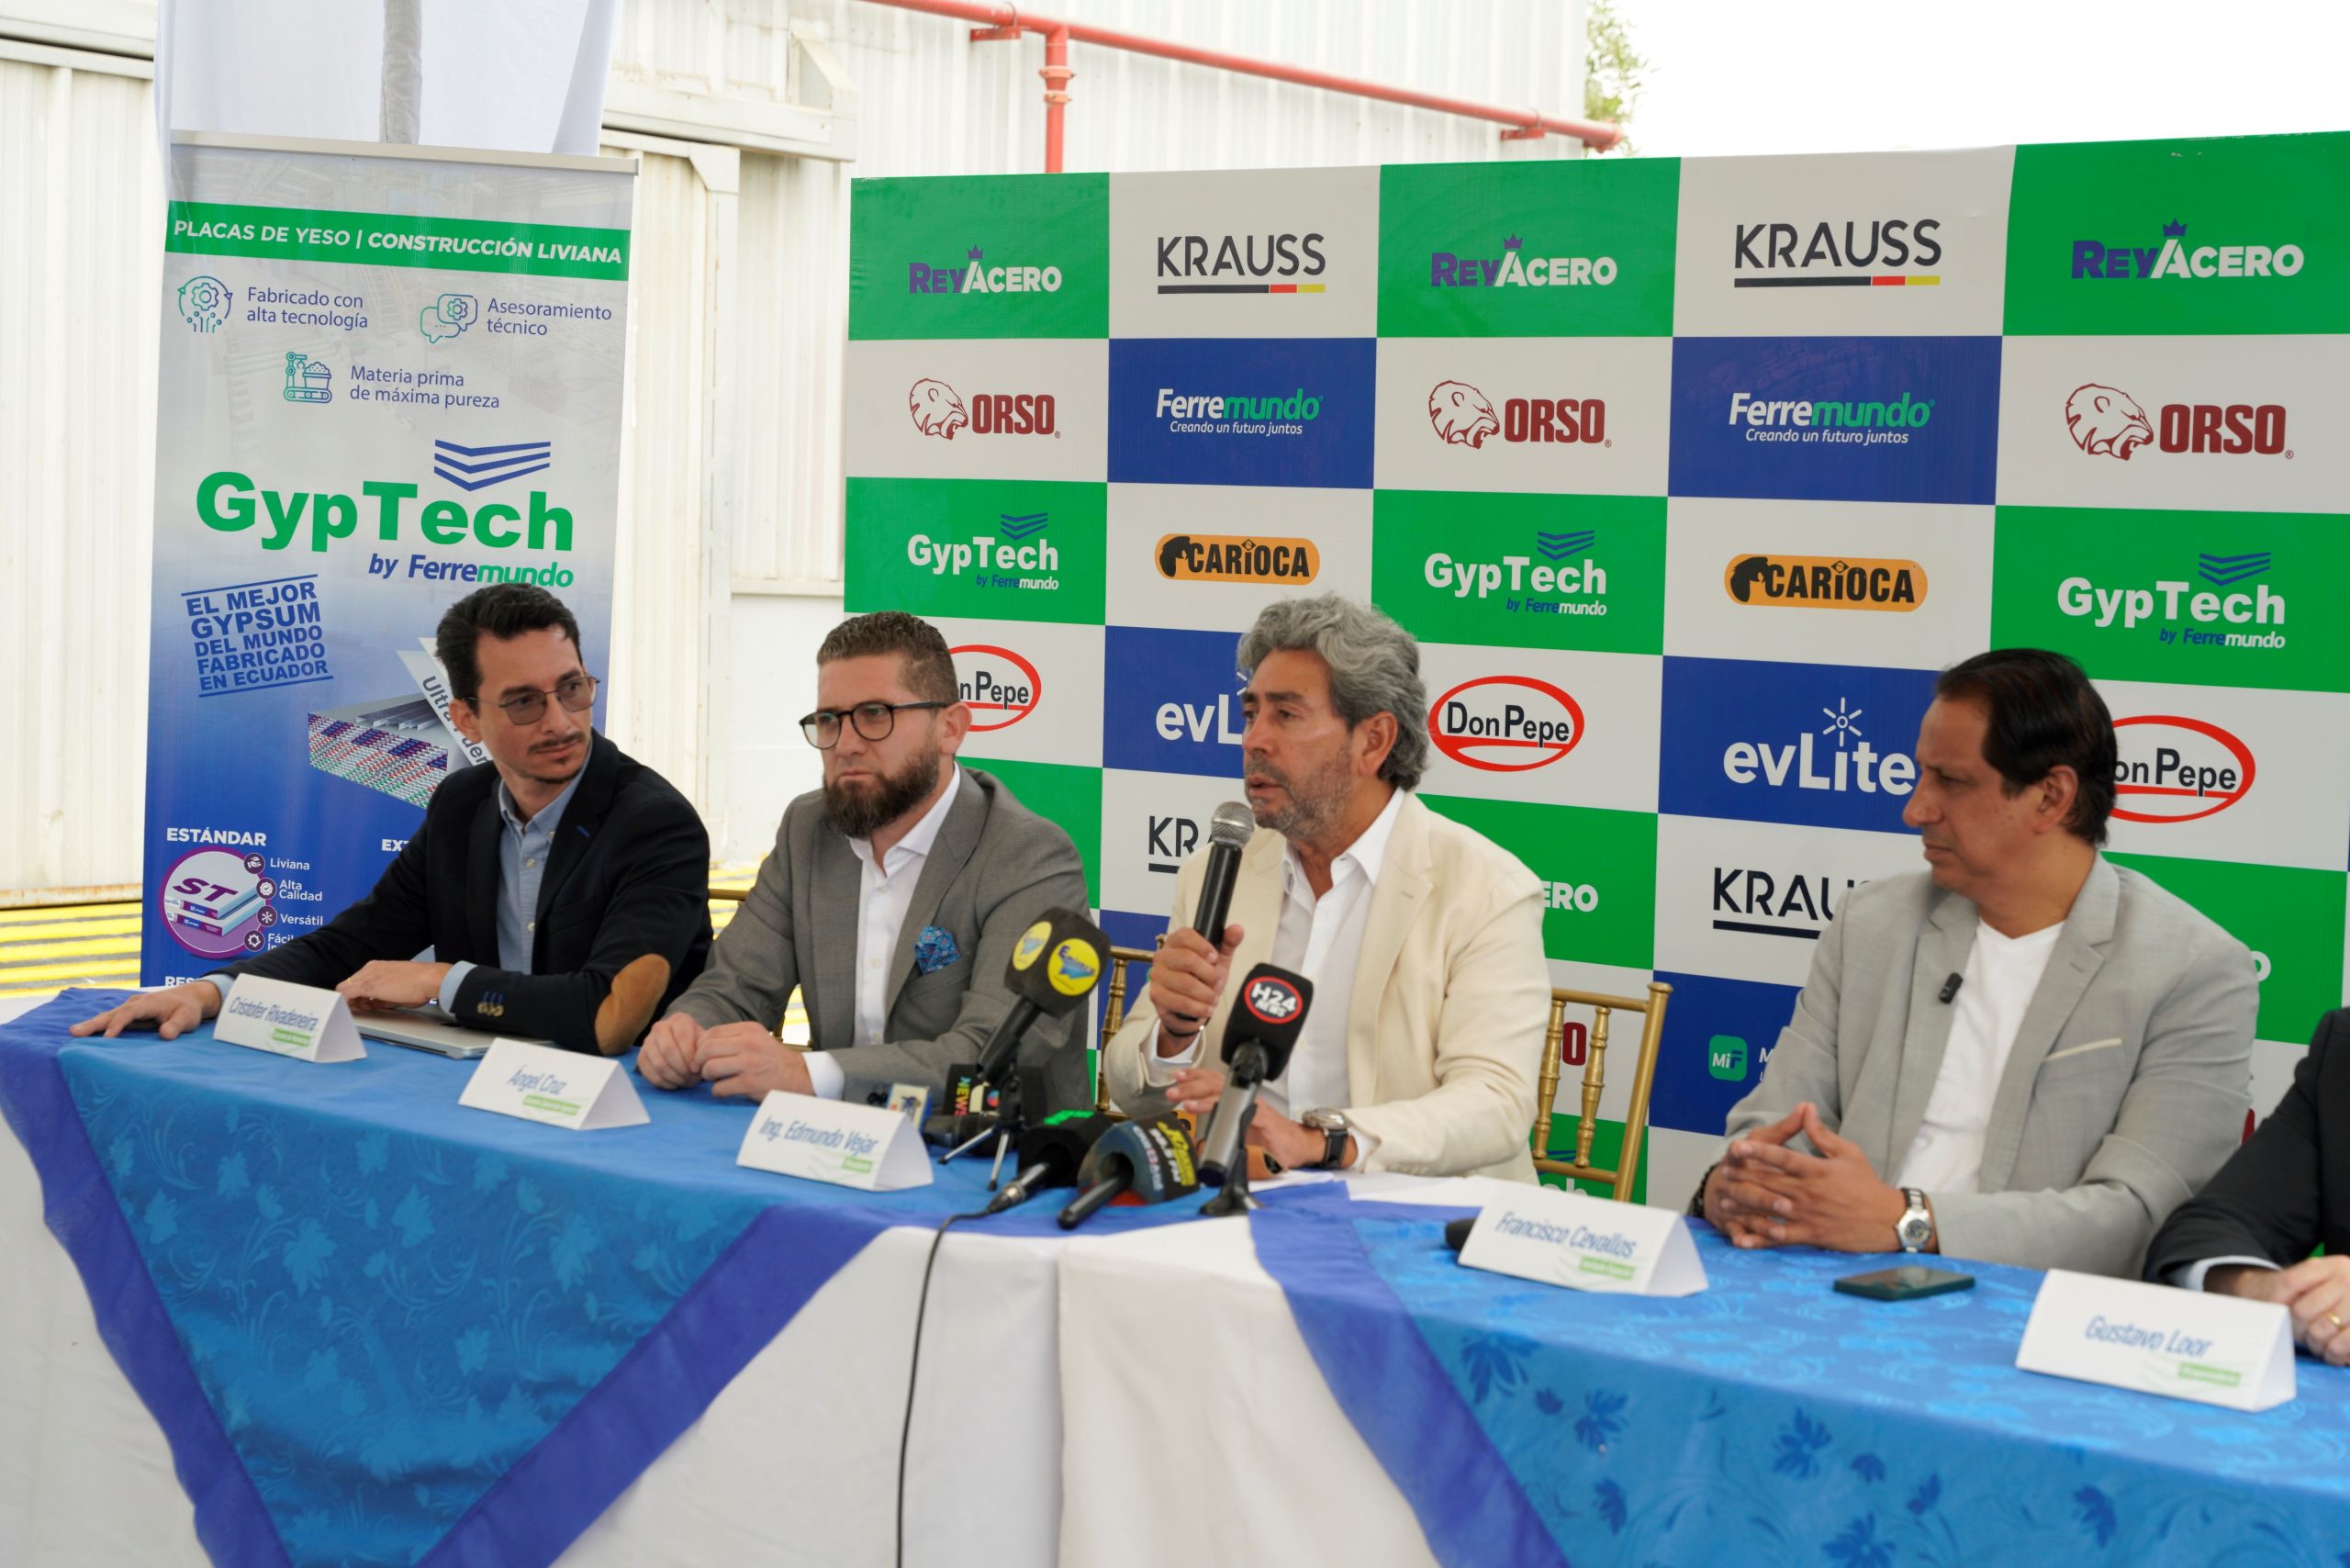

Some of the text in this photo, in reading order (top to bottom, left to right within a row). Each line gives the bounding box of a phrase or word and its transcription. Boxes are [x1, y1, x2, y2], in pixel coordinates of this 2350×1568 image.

[173, 219, 622, 264] PLACAS DE YESO CONSTRUCCIÓN LIVIANA
[1158, 233, 1326, 278] KRAUSS
[1734, 219, 1942, 269] KRAUSS
[248, 286, 364, 308] Fabricado con
[487, 297, 612, 320] Asesoramiento
[247, 307, 368, 332] alta tecnología
[487, 317, 548, 336] técnico
[351, 365, 464, 390] Materia prima
[350, 386, 499, 410] de máxima pureza
[1157, 388, 1320, 420] Ferremundo
[1729, 392, 1930, 429] Ferremundo
[1170, 420, 1303, 436] Creando un futuro juntos
[1745, 428, 1909, 446] Creando un futuro juntos
[196, 471, 574, 552] GypTech
[908, 534, 1058, 577] GypTech
[369, 554, 574, 588] by Ferremundo
[976, 575, 1059, 590] by Ferremundo
[1424, 553, 1607, 598] GypTech
[186, 581, 317, 616] EL MEJOR
[1506, 598, 1607, 616] by Ferremundo
[2057, 577, 2286, 628] GypTech
[191, 601, 320, 639] GYPSUM
[195, 625, 322, 656] DEL MUNDO
[2159, 627, 2286, 649] by Ferremundo
[197, 643, 325, 675] FABRICADO
[199, 660, 328, 690] EN ECUADOR
[976, 671, 1028, 710] Pepe
[1156, 693, 1243, 745] evL
[1723, 733, 1917, 796] evLite
[2114, 747, 2236, 797] on Pepe
[166, 826, 267, 846] ESTÁNDAR
[270, 857, 310, 870] Liviana
[173, 878, 239, 902] ST
[279, 879, 302, 890] Alta
[279, 889, 323, 902] Calidad
[280, 913, 323, 925] Versátil
[1251, 982, 1296, 1012] H24
[540, 1074, 567, 1094] Cruz
[785, 1120, 844, 1148] Edmundo
[1495, 1212, 1570, 1248] Francisco
[2086, 1316, 2165, 1350] Gustavo
